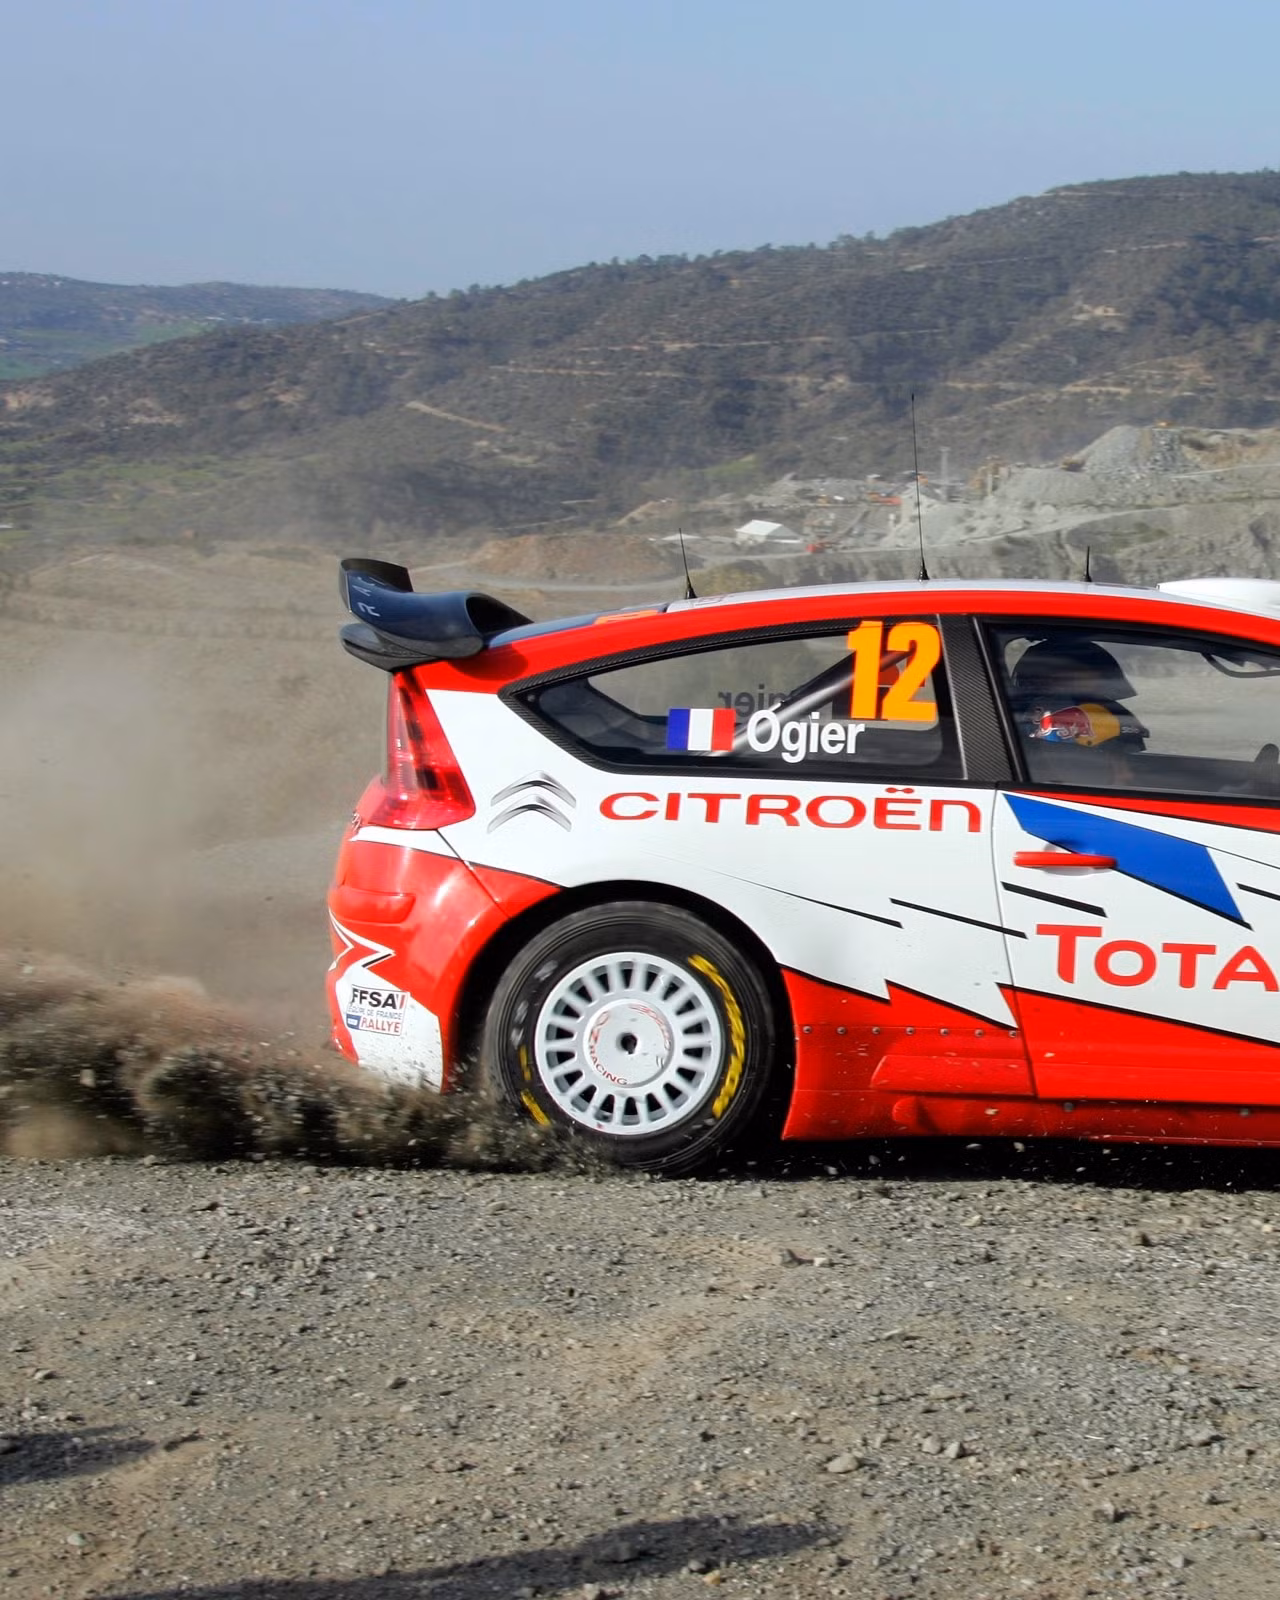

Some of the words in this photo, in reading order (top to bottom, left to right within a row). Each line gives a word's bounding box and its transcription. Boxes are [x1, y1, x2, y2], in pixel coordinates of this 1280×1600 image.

[846, 620, 942, 722] 12
[747, 709, 865, 763] Ogier
[350, 987, 397, 1010] FFSA
[361, 1017, 402, 1033] RALLYE
